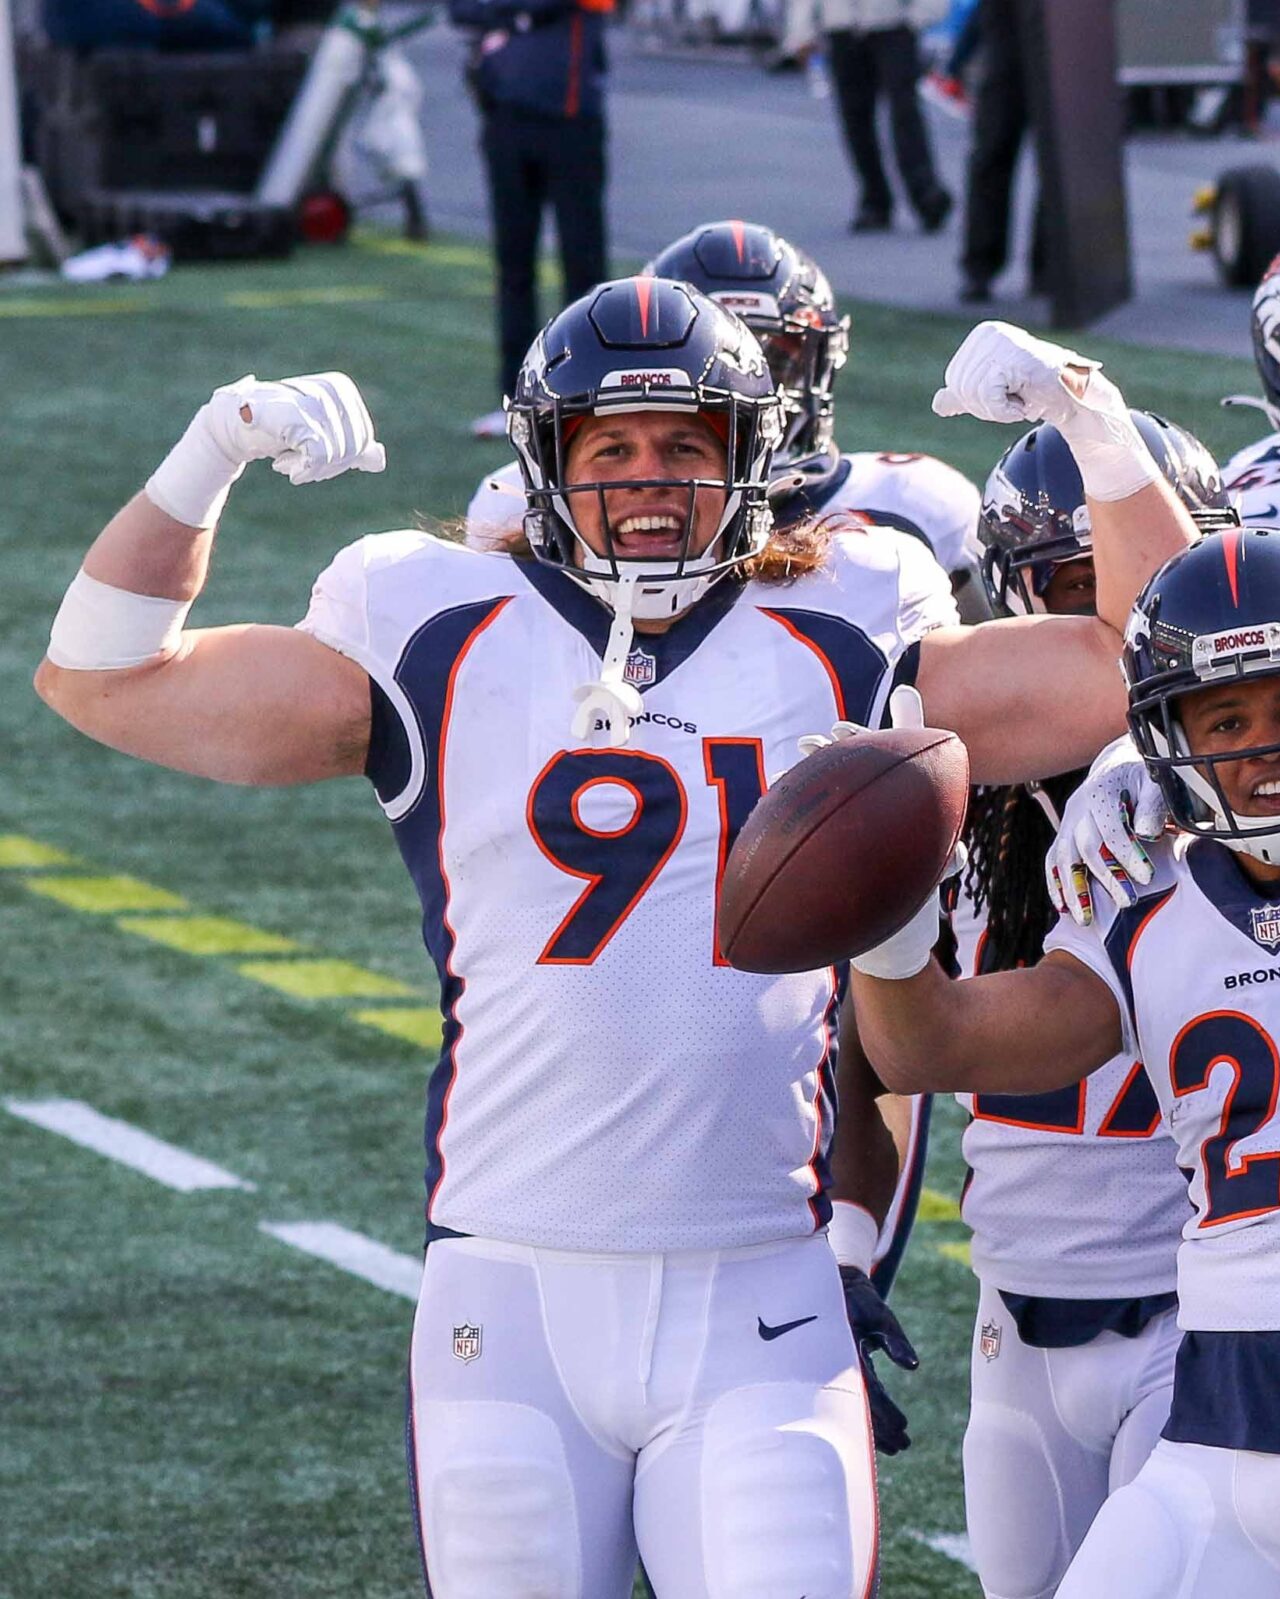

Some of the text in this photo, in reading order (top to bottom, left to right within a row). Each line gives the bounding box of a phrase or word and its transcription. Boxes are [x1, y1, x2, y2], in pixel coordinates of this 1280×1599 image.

[621, 373, 671, 385] BRONCOS
[1214, 630, 1264, 653] BRONCOS
[627, 665, 650, 680] NFL
[526, 736, 767, 966] 91
[456, 1339, 476, 1356] NFL
